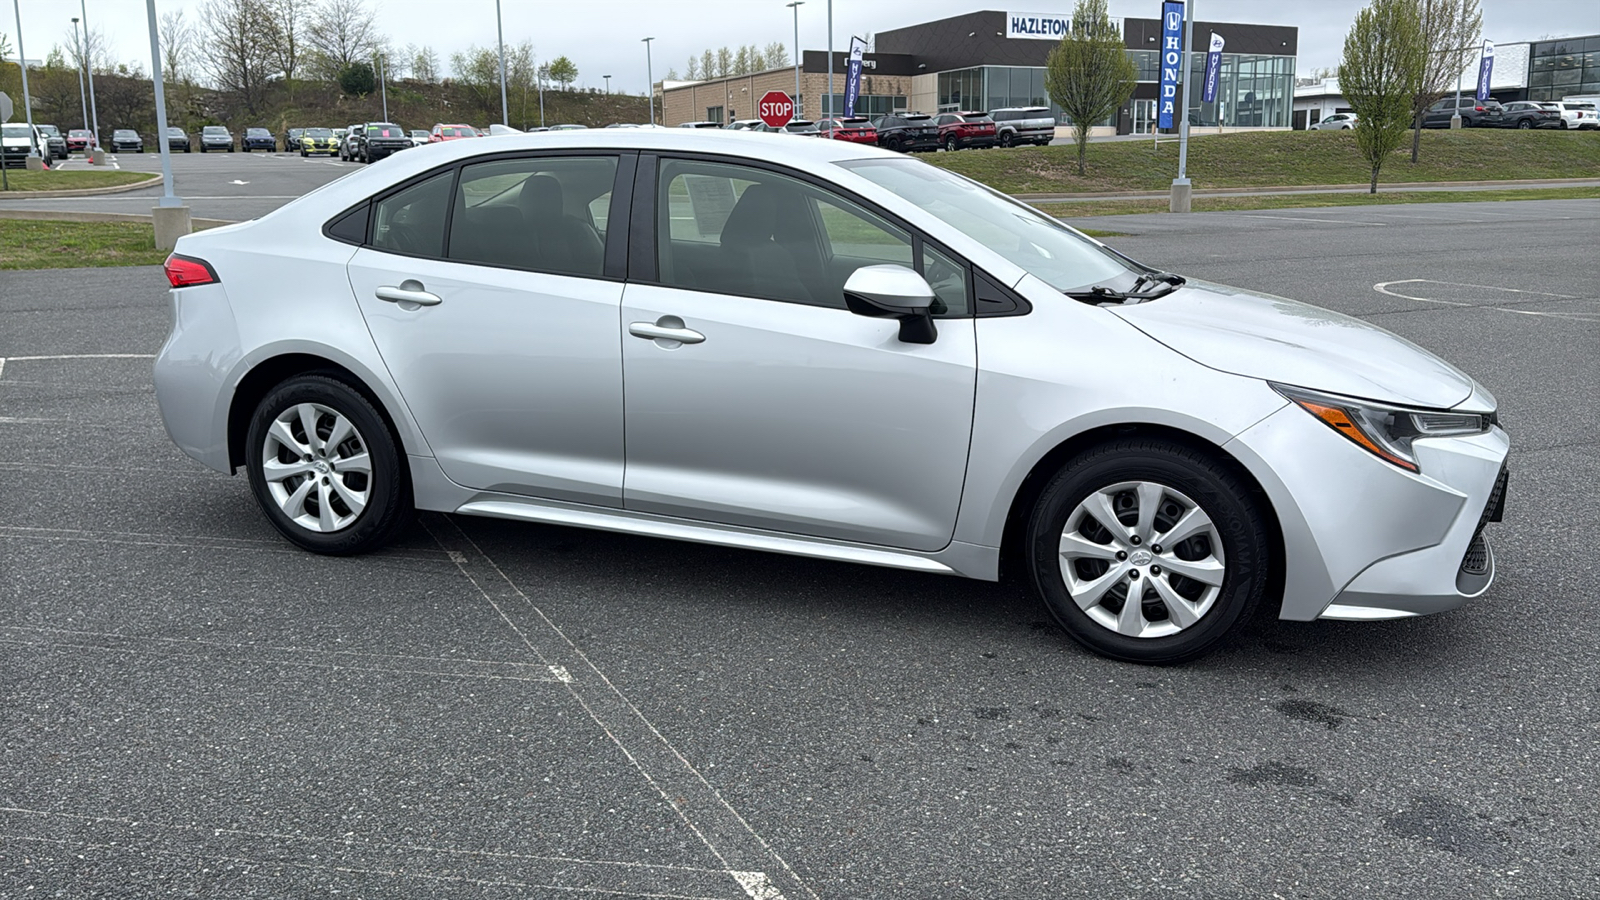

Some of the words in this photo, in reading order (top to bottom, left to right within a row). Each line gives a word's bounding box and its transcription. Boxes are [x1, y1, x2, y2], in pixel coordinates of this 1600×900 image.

[1012, 17, 1069, 35] HAZLETON
[848, 62, 859, 116] HYUNDAI
[1162, 36, 1179, 114] HONDA
[1208, 54, 1219, 101] HYUNDAI
[1481, 59, 1490, 100] HYUNDAI
[761, 102, 792, 117] STOP
